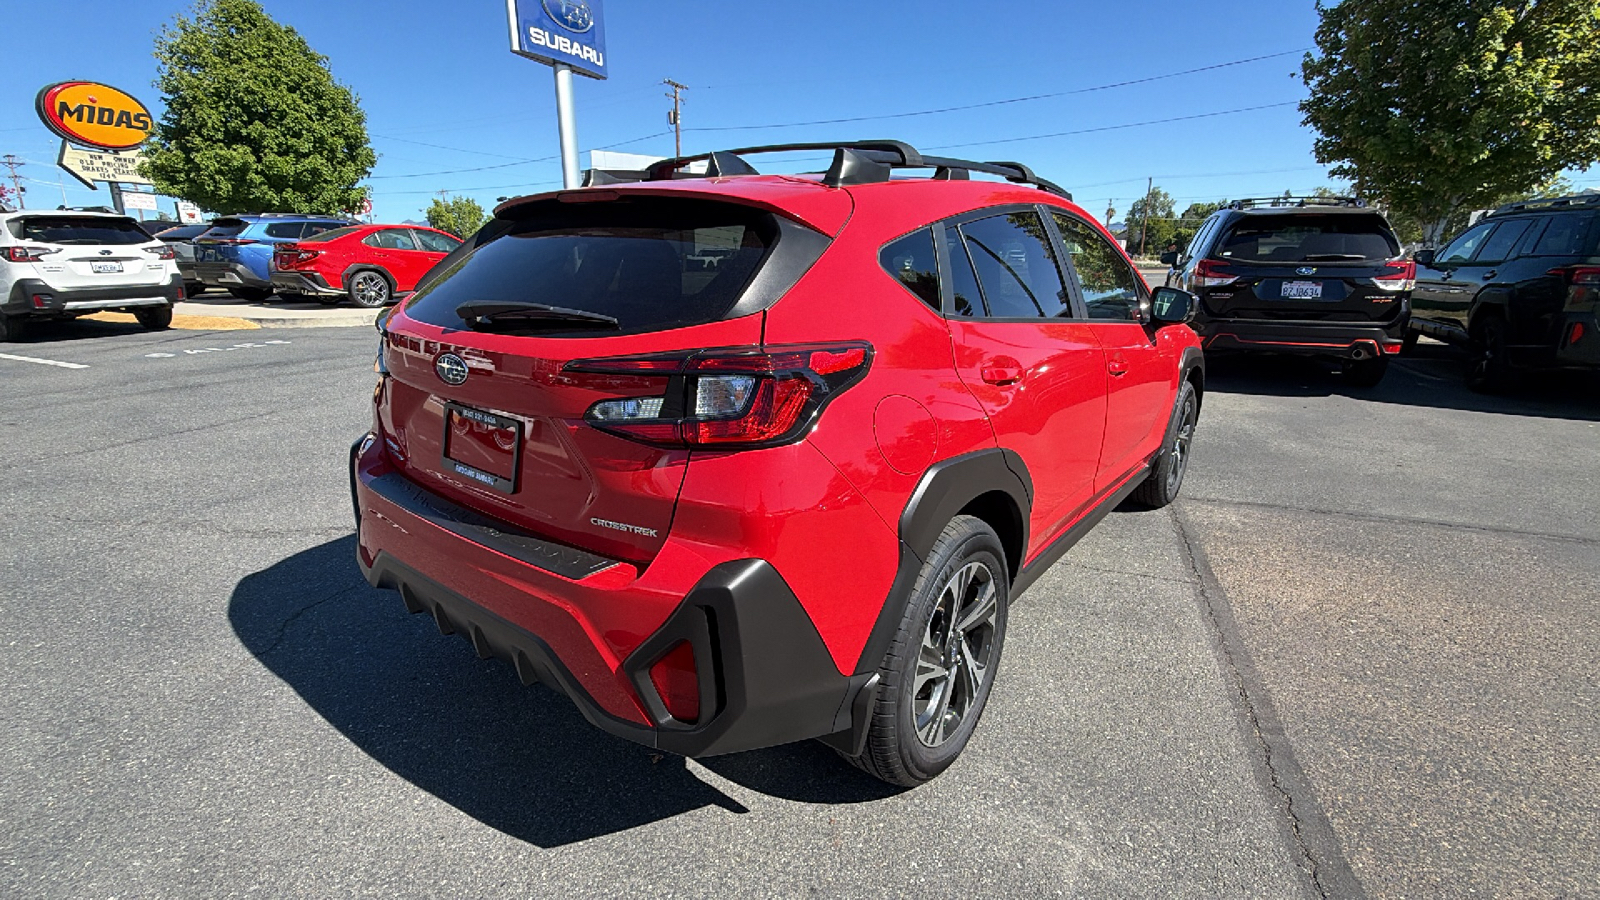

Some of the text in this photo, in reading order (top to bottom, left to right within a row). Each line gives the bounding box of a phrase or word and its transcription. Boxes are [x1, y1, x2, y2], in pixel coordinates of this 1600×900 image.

[529, 26, 604, 67] SUBARU
[58, 96, 149, 131] MIDAS
[590, 517, 658, 538] CROSSTREK
